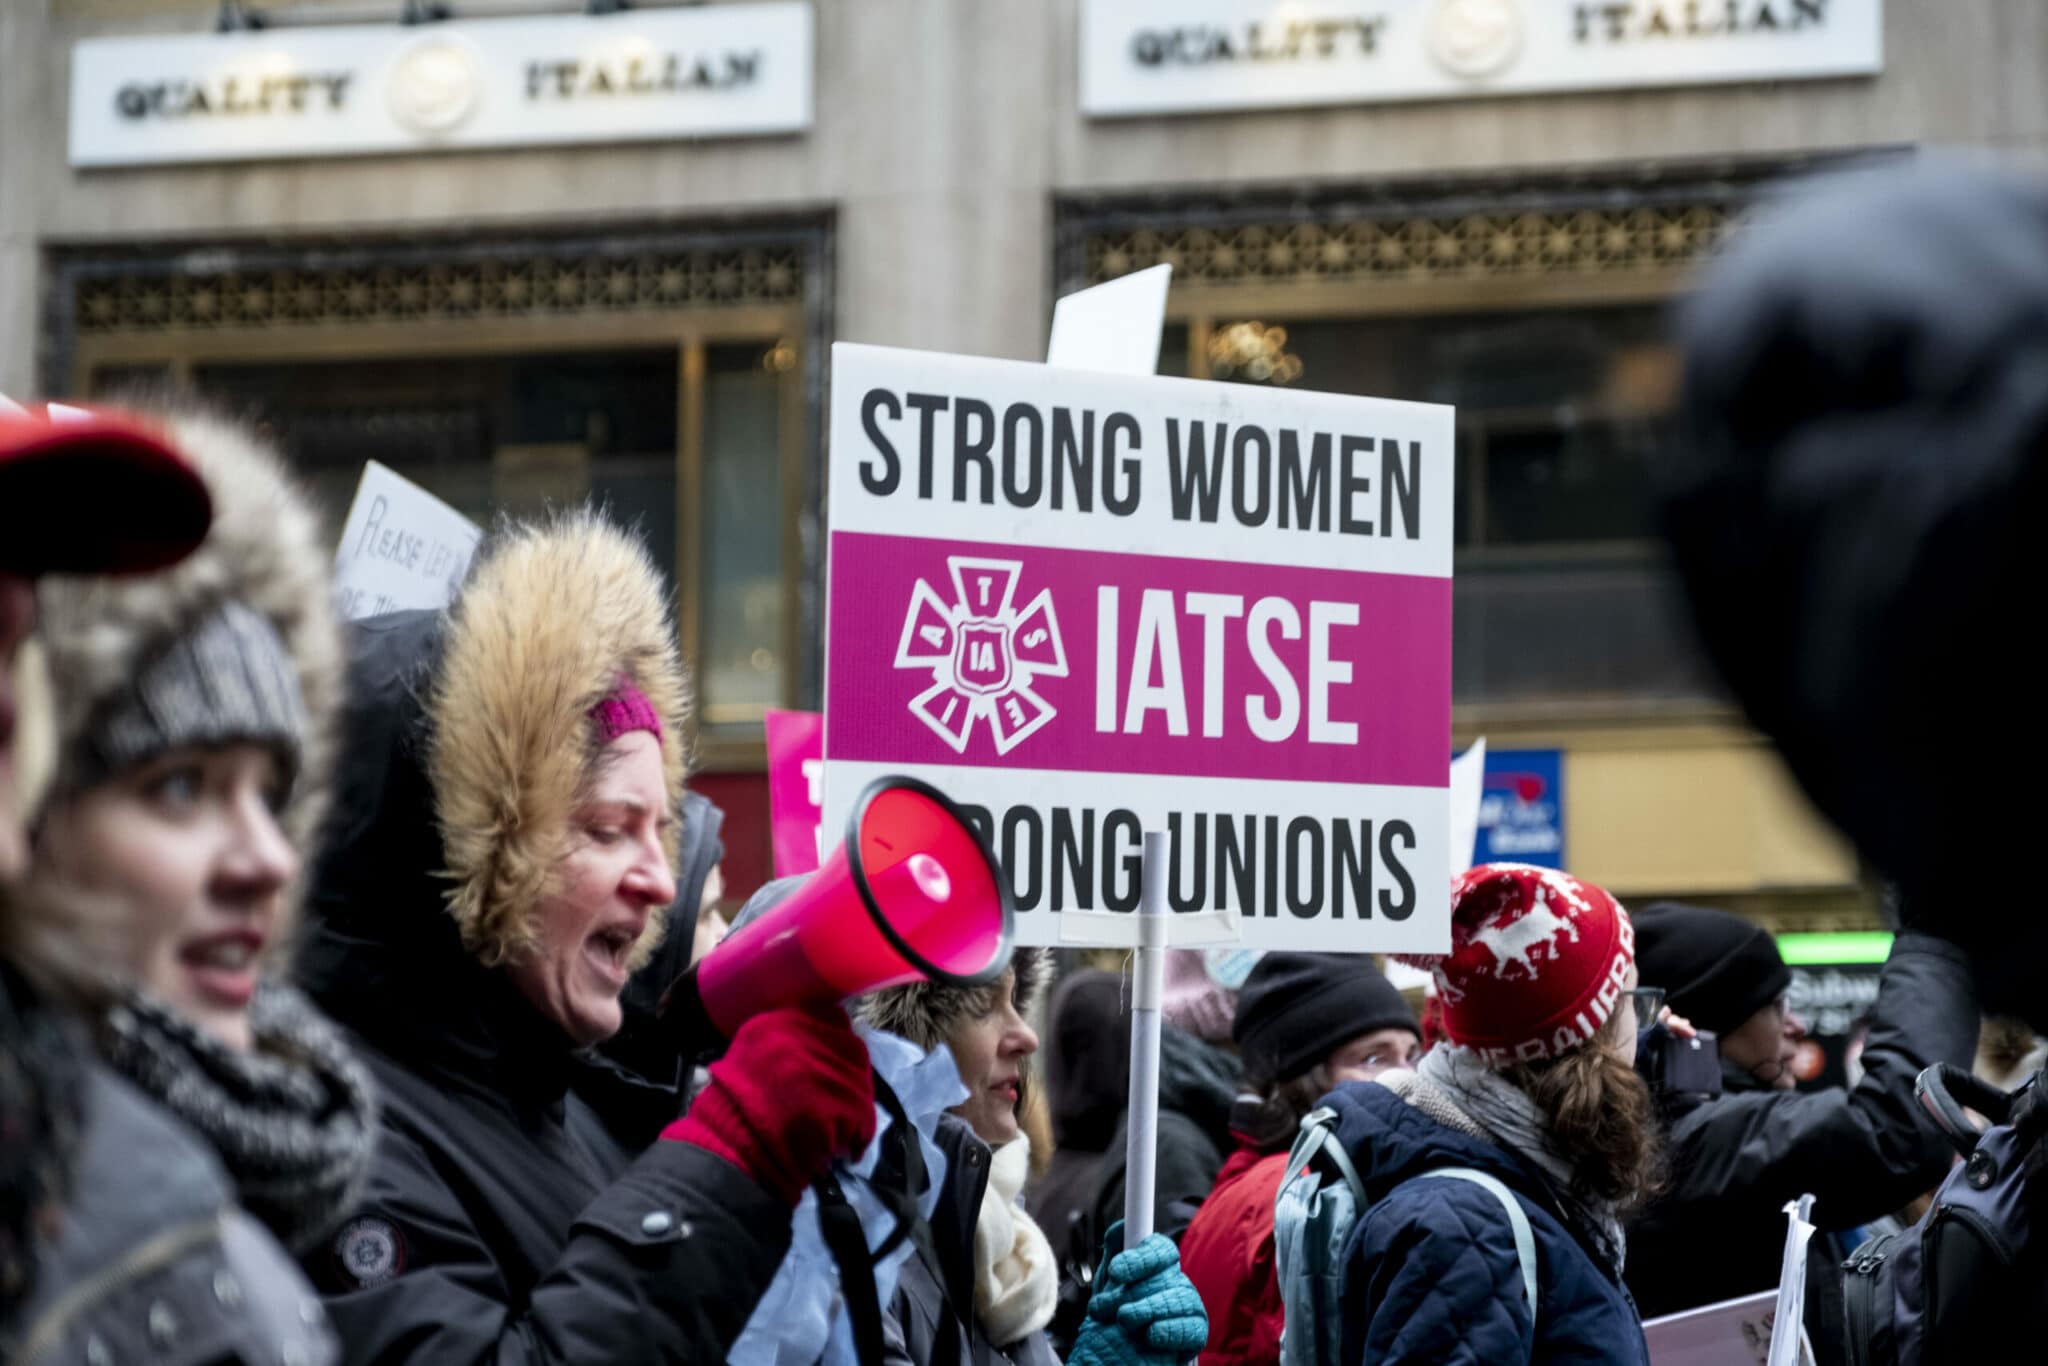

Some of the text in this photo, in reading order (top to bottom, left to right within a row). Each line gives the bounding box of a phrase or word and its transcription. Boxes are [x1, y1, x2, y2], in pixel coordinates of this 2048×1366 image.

[1131, 0, 1828, 67] QUALITY ITALIAN
[115, 50, 762, 122] QUALITY ITALIAN
[858, 387, 1422, 541] STRONG WOMEN
[969, 640, 996, 672] IA
[1095, 584, 1361, 746] IATSE
[1168, 811, 1418, 923] UNIONS
